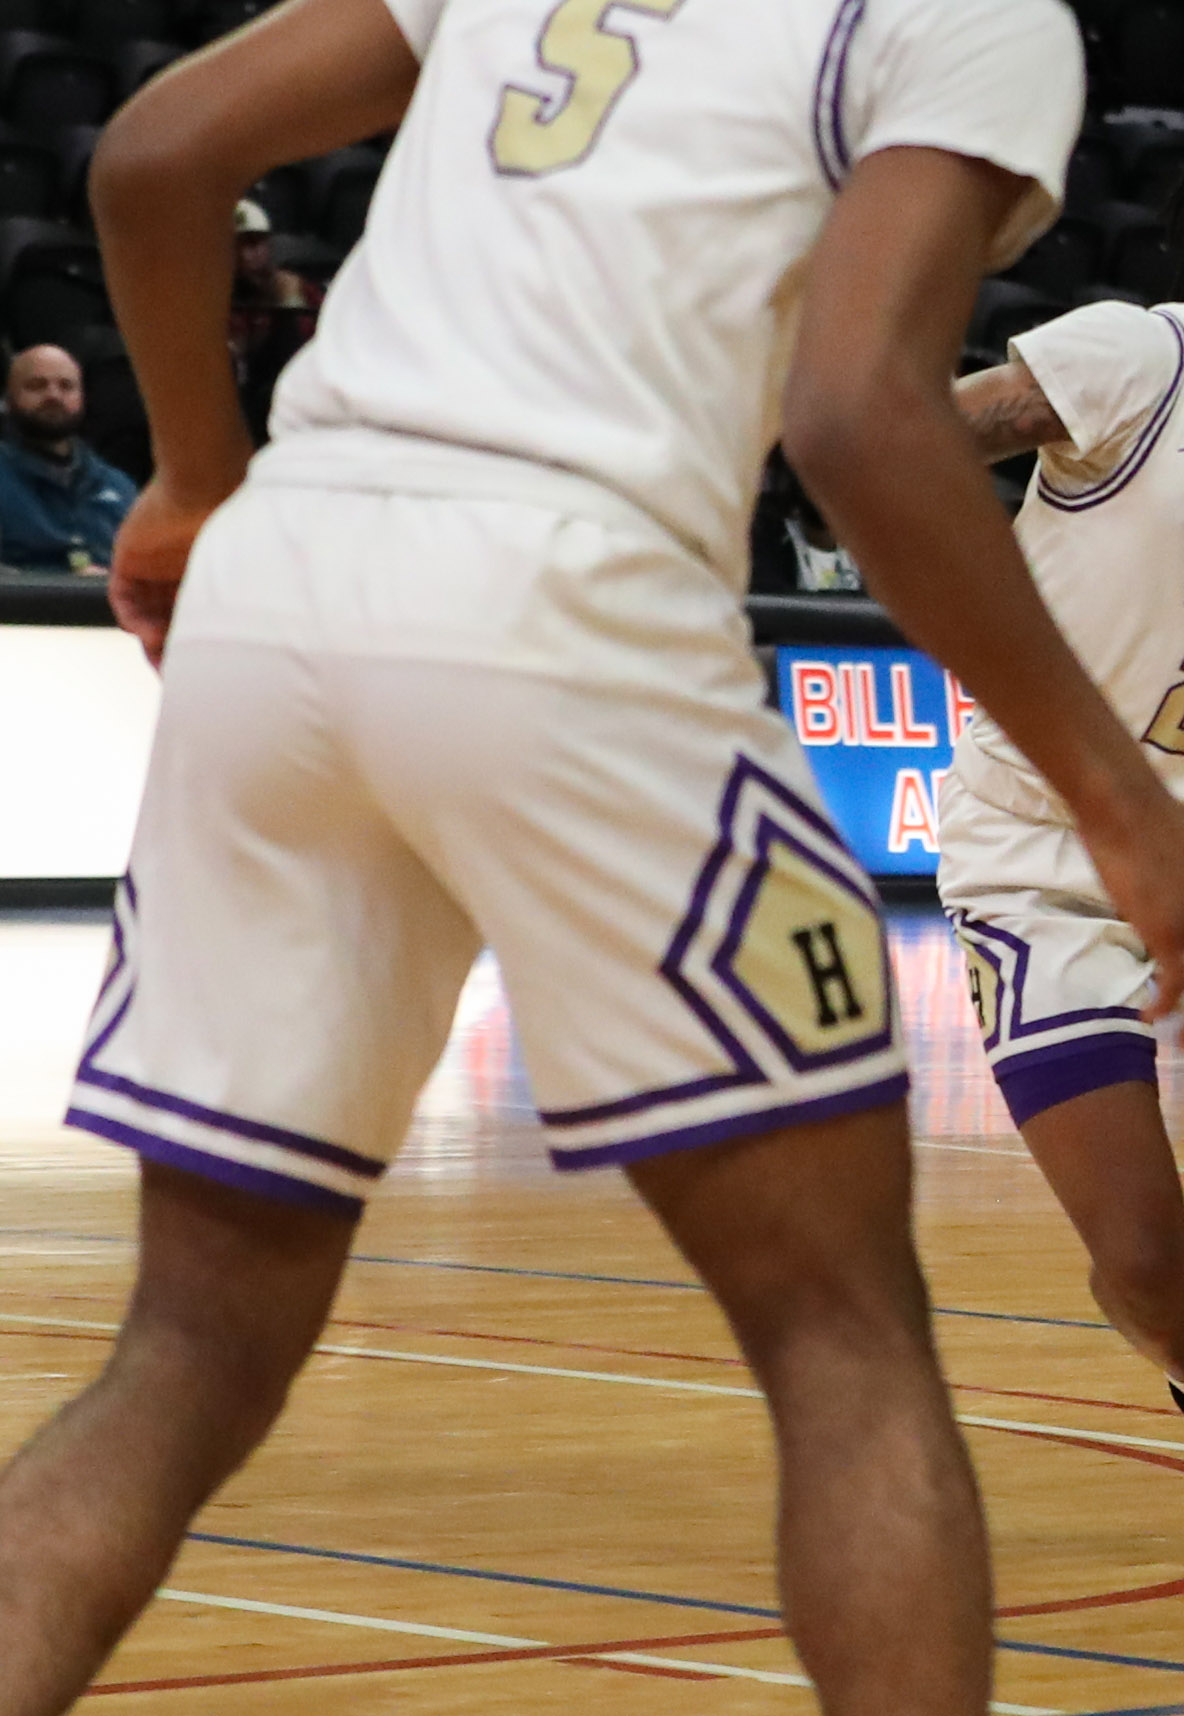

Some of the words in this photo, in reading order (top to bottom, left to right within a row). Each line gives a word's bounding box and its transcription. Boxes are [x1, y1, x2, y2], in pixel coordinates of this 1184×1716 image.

[486, 0, 687, 179] 5
[790, 661, 938, 748] BILL
[788, 922, 864, 1028] H
